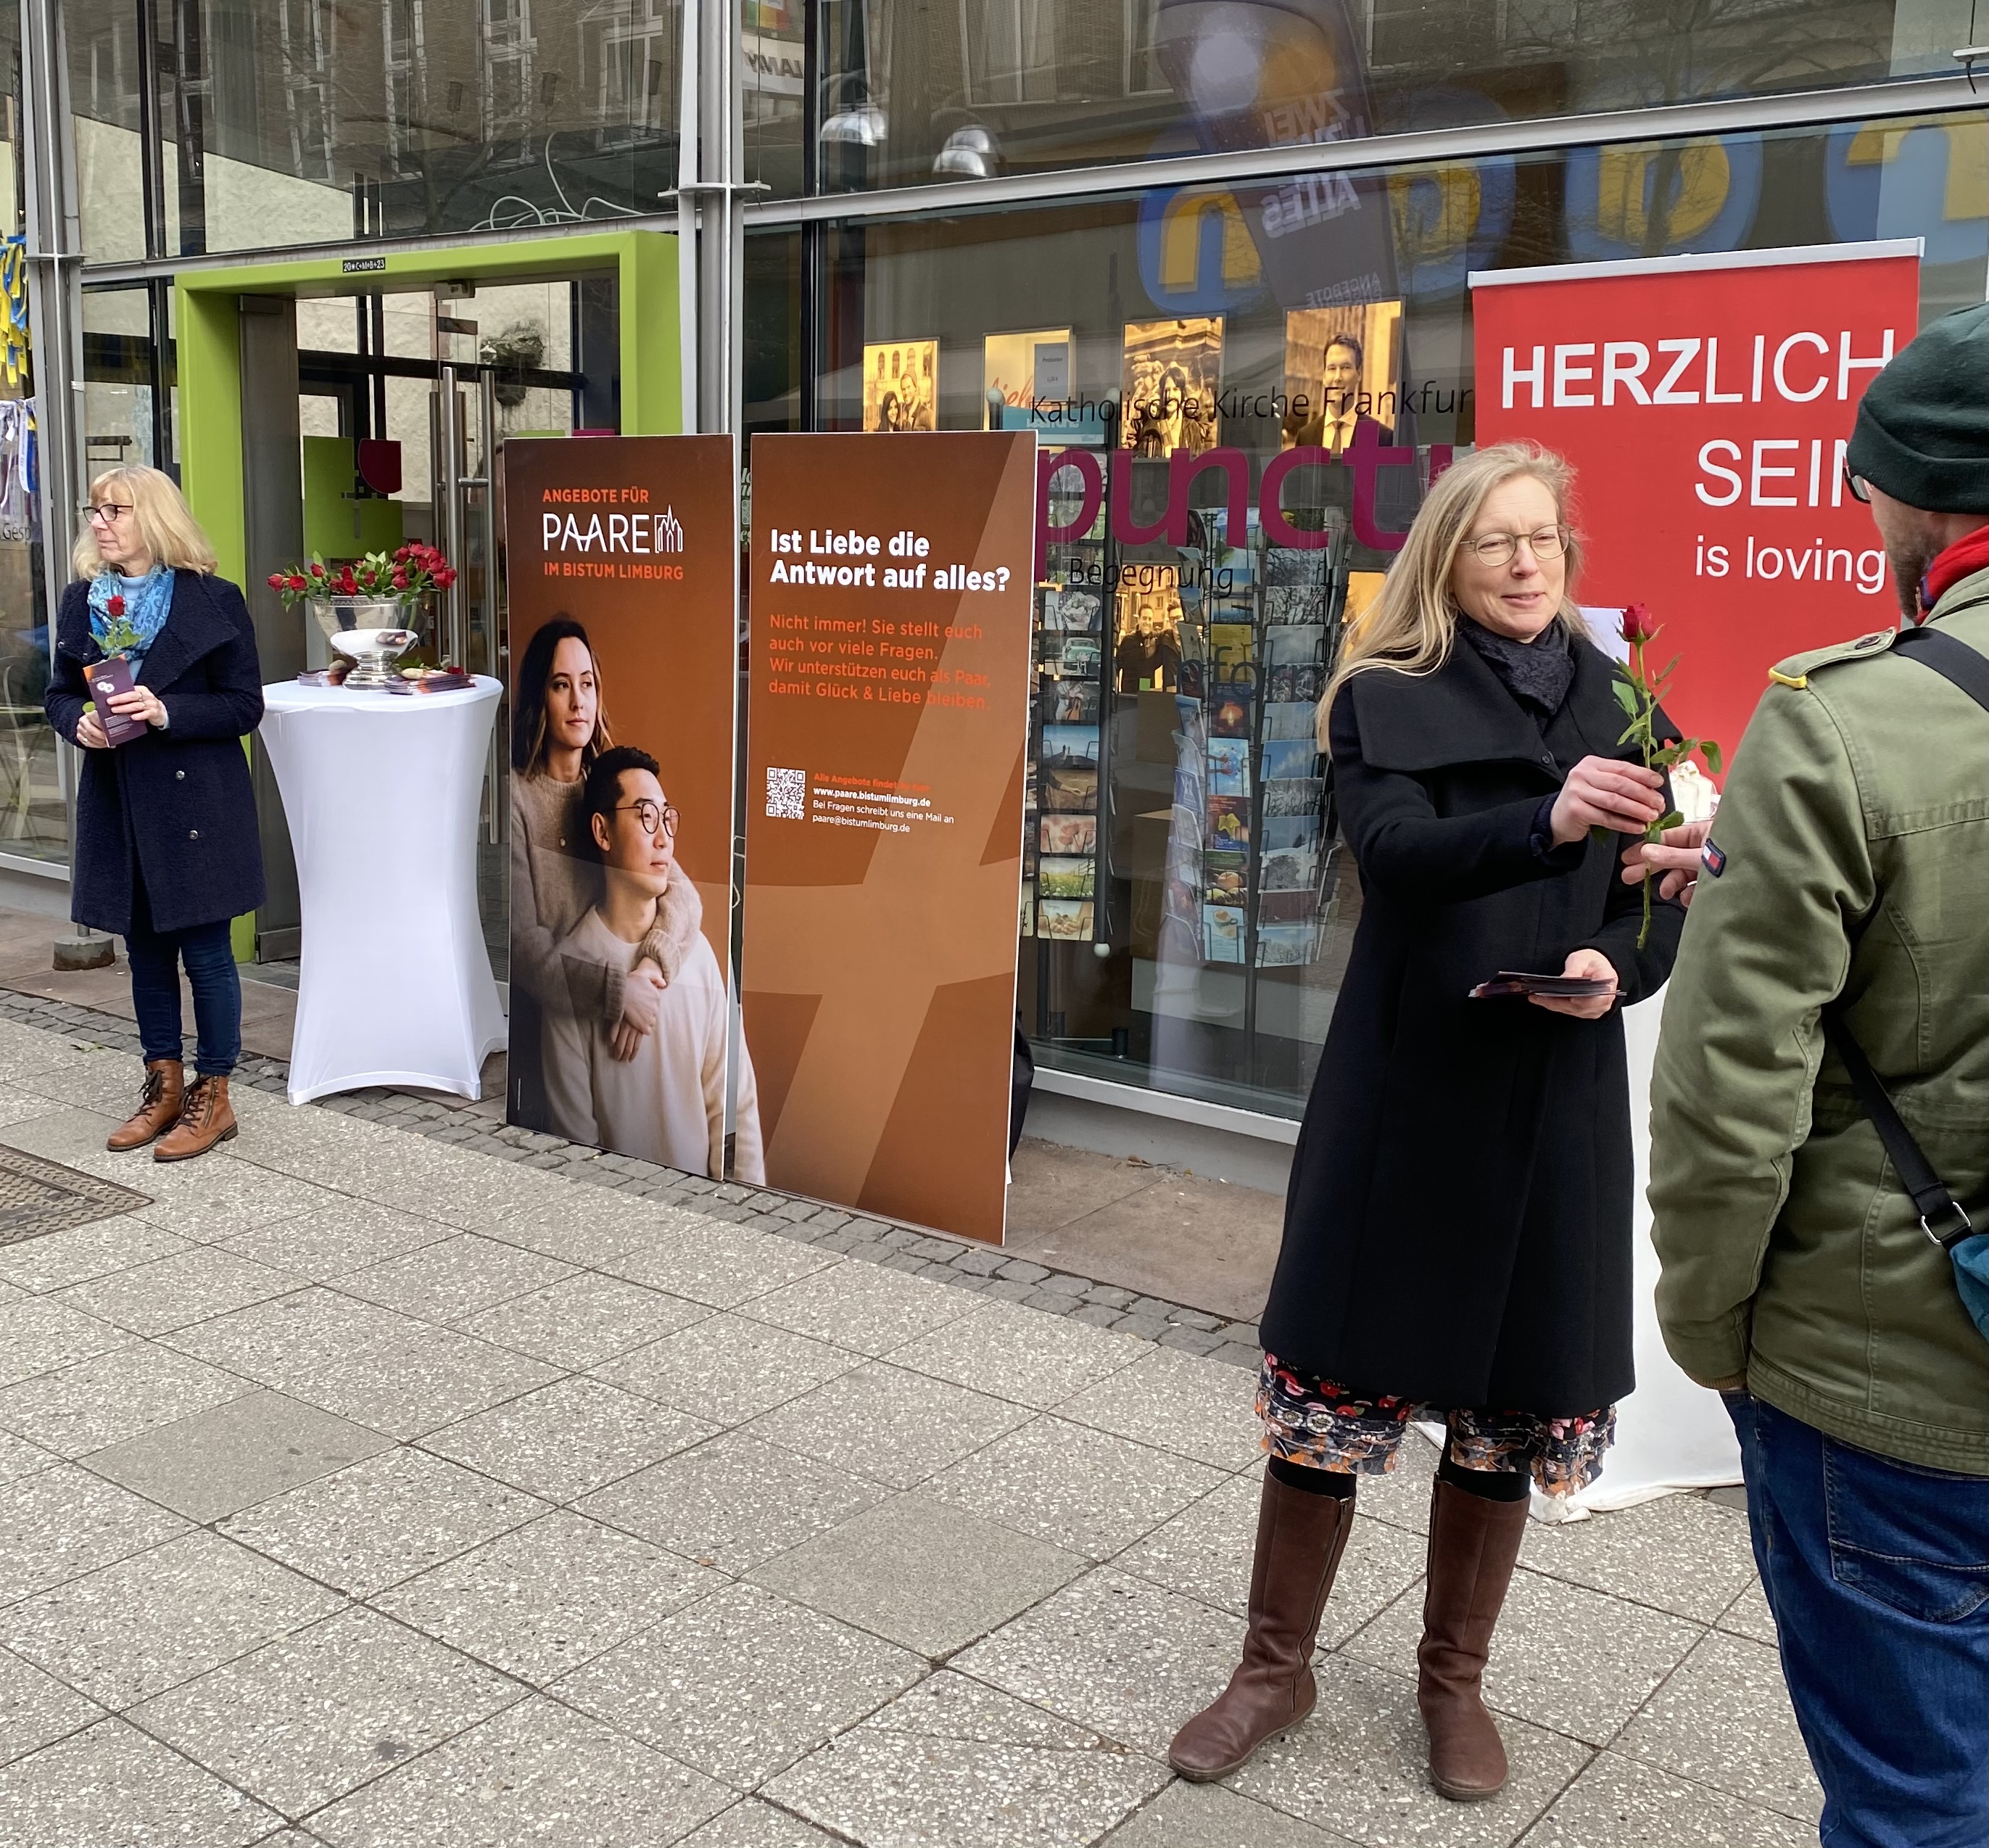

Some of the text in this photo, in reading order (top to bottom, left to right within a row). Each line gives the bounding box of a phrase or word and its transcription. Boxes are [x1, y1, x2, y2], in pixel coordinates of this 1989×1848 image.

[1502, 329, 1895, 409] HERZLICH
[1030, 392, 1199, 423] Katholische
[1213, 385, 1309, 418] Kirche
[542, 485, 649, 504] ANGEBOTE FÜR
[542, 512, 650, 554] PAARE
[771, 528, 803, 554] Ist
[810, 529, 880, 556] Liebe
[888, 530, 930, 558] die
[544, 561, 684, 581] IM BISTUM LIMBURG
[770, 558, 1011, 593] Antwort auf alles?
[1070, 558, 1233, 598] Begegnung
[1695, 535, 1885, 595] is loving
[770, 614, 983, 640] Nicht immer! Sie stellt euch
[769, 637, 939, 661] auch vor viele Fragen.
[769, 657, 794, 673] Wir
[798, 661, 887, 680] unterstützen
[891, 667, 927, 682] euch
[930, 669, 951, 684] als
[769, 679, 811, 696] damit
[816, 682, 859, 700] Glück
[863, 686, 874, 701] &
[879, 687, 922, 705] Liebe
[814, 772, 830, 783] Alle
[831, 774, 871, 787] Angebote
[872, 778, 898, 790] findet
[813, 787, 931, 807] www.paare.bistumlimburg.de
[812, 814, 911, 833] paare@bistumlimburg.de
[813, 799, 955, 825] Bei Fragen schreibt uns eine Mail an
